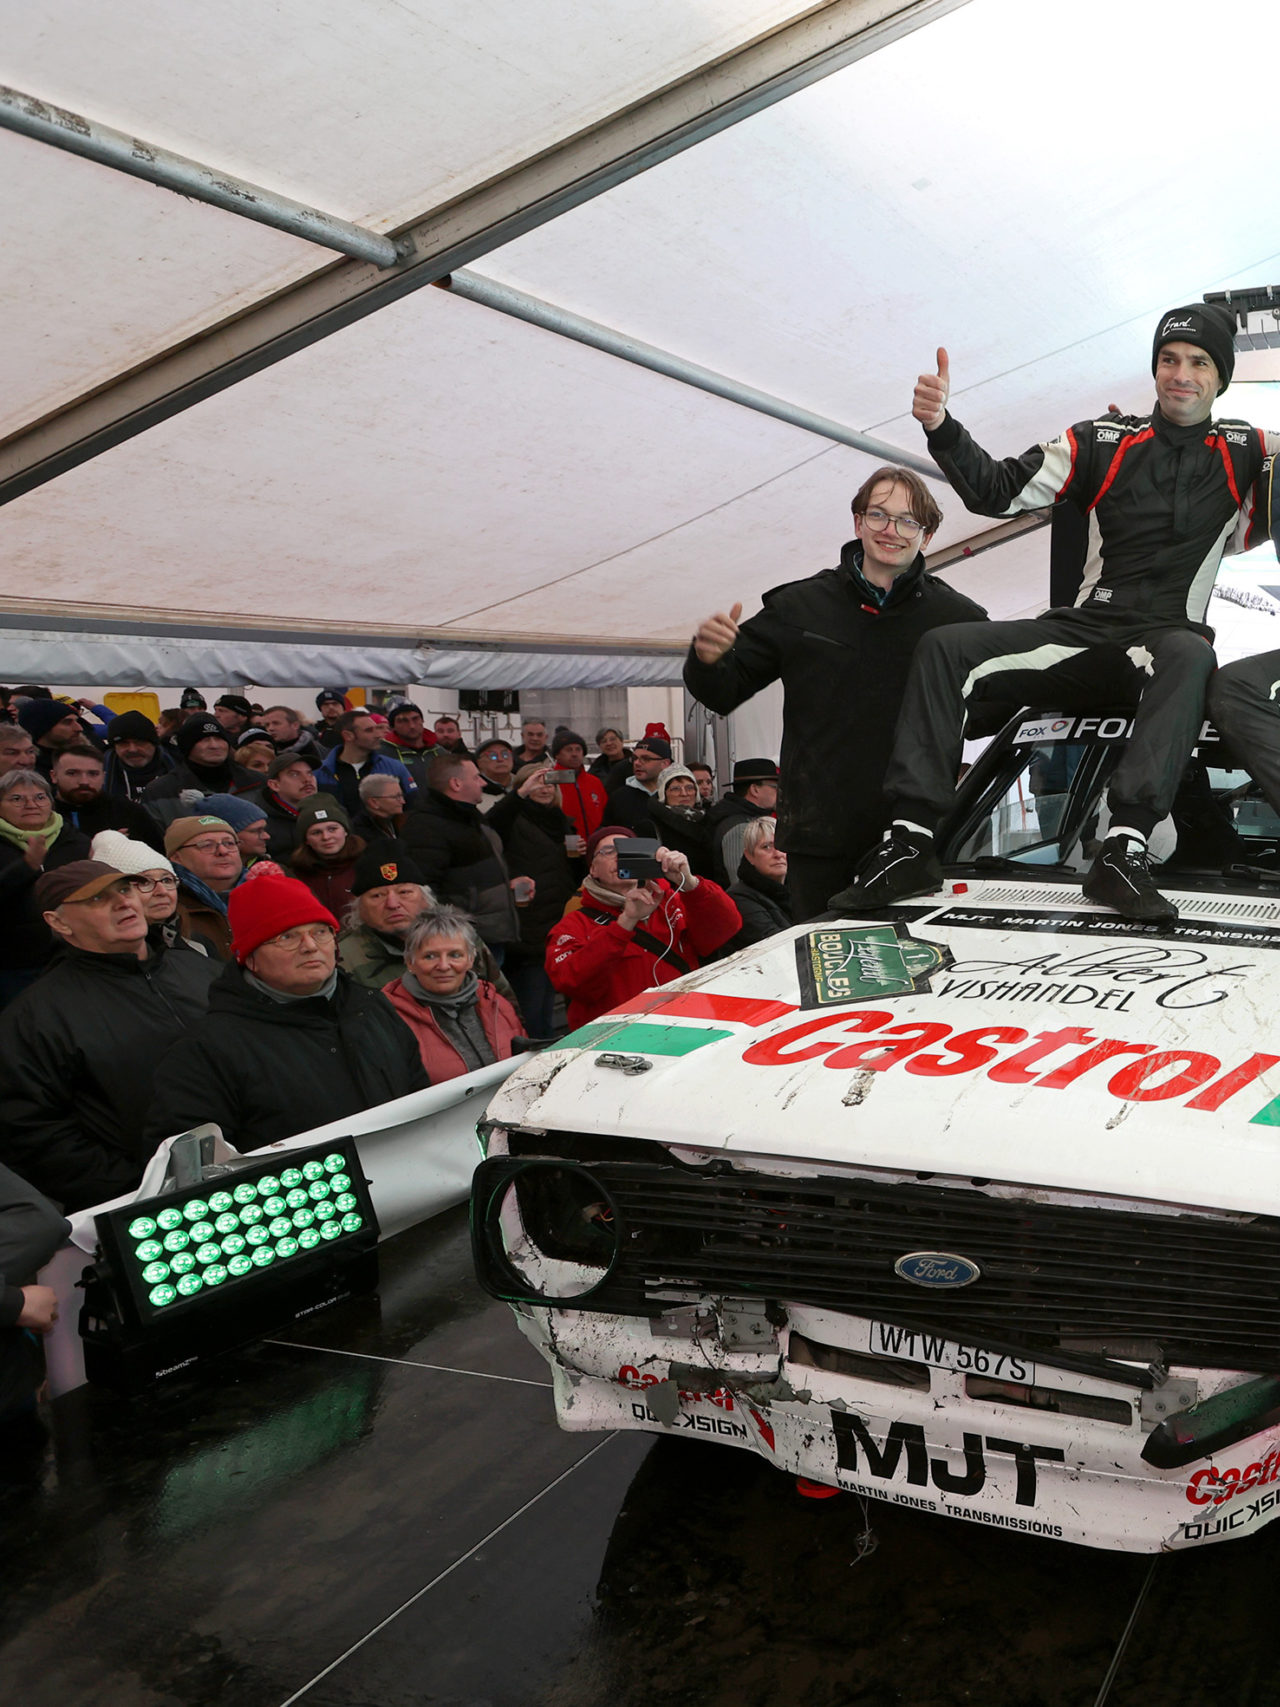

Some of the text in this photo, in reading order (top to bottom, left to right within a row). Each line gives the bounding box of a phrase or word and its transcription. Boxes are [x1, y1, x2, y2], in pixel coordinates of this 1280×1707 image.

[1097, 430, 1120, 442] OMP
[1226, 432, 1247, 444] OMP
[1095, 590, 1112, 600] OMP
[1019, 726, 1048, 738] FOX
[942, 913, 995, 922] MJT
[1001, 916, 1084, 928] MARTIN
[1088, 923, 1159, 932] JONES
[820, 933, 851, 998] BOUCLES
[945, 946, 1256, 1009] Albert
[938, 979, 1137, 1012] VISHANDEL
[914, 1258, 959, 1281] Ford
[879, 1323, 1026, 1381] WTW 567S
[830, 1409, 1065, 1507] MJT
[837, 1479, 1063, 1537] MARTIN JONES TRANSMISSIONS
